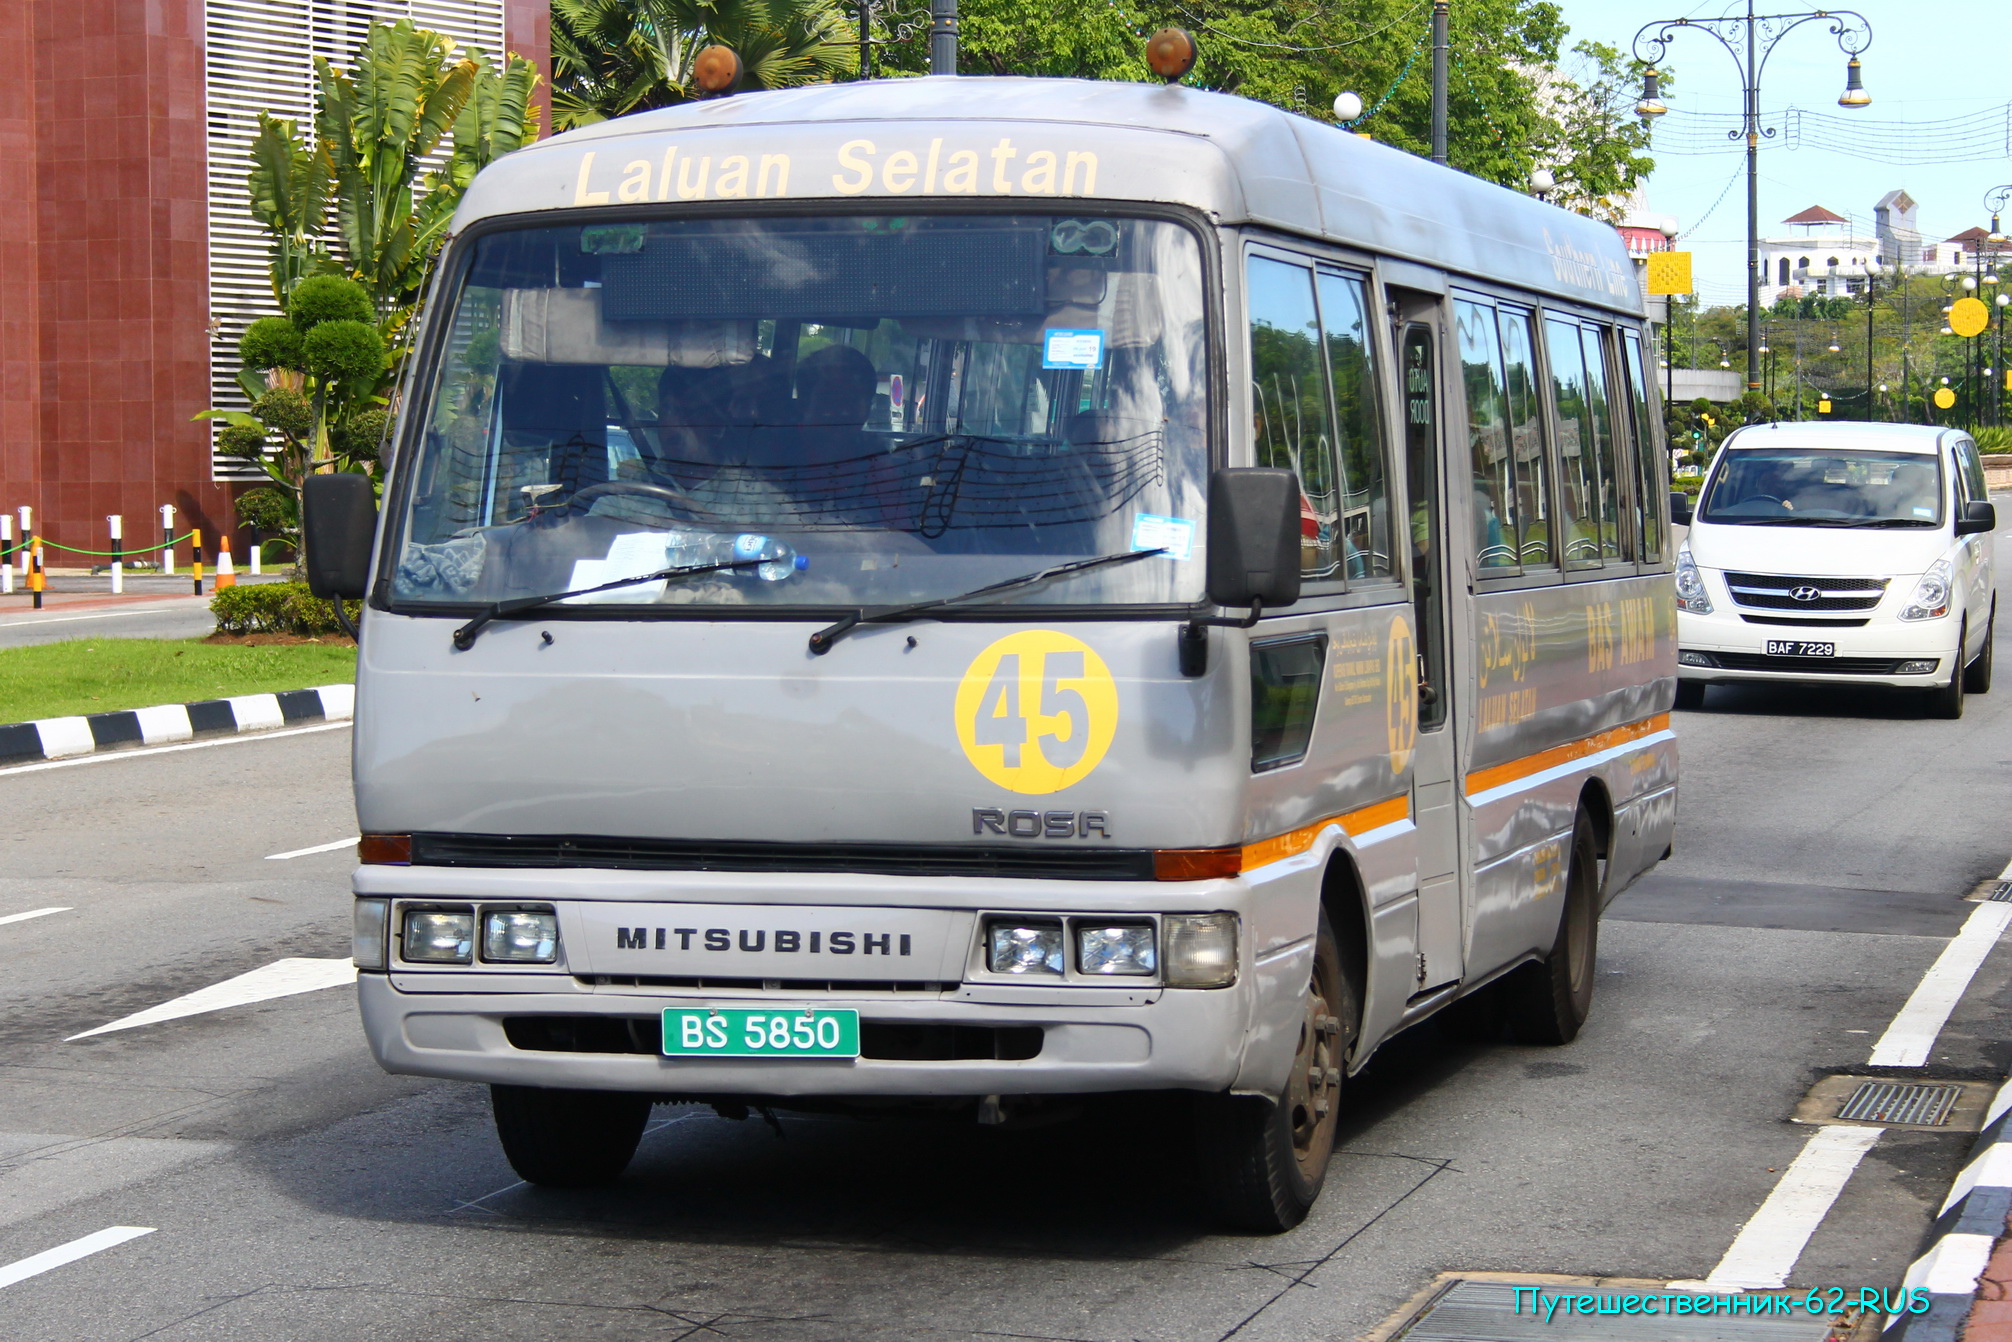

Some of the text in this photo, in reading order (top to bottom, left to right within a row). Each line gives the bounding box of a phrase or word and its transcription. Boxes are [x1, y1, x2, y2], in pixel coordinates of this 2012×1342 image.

[573, 138, 1099, 206] Laluan Selatan
[1541, 226, 1628, 298] Southern Line
[1586, 602, 1613, 673] BAS
[1620, 597, 1655, 665] AWAM
[1768, 641, 1833, 655] BAF 7229
[974, 651, 1090, 768] 45
[1390, 636, 1412, 751] 45
[972, 806, 1111, 838] ROSA
[617, 927, 912, 956] MITSUBISHI
[681, 1015, 841, 1050] BS 5850
